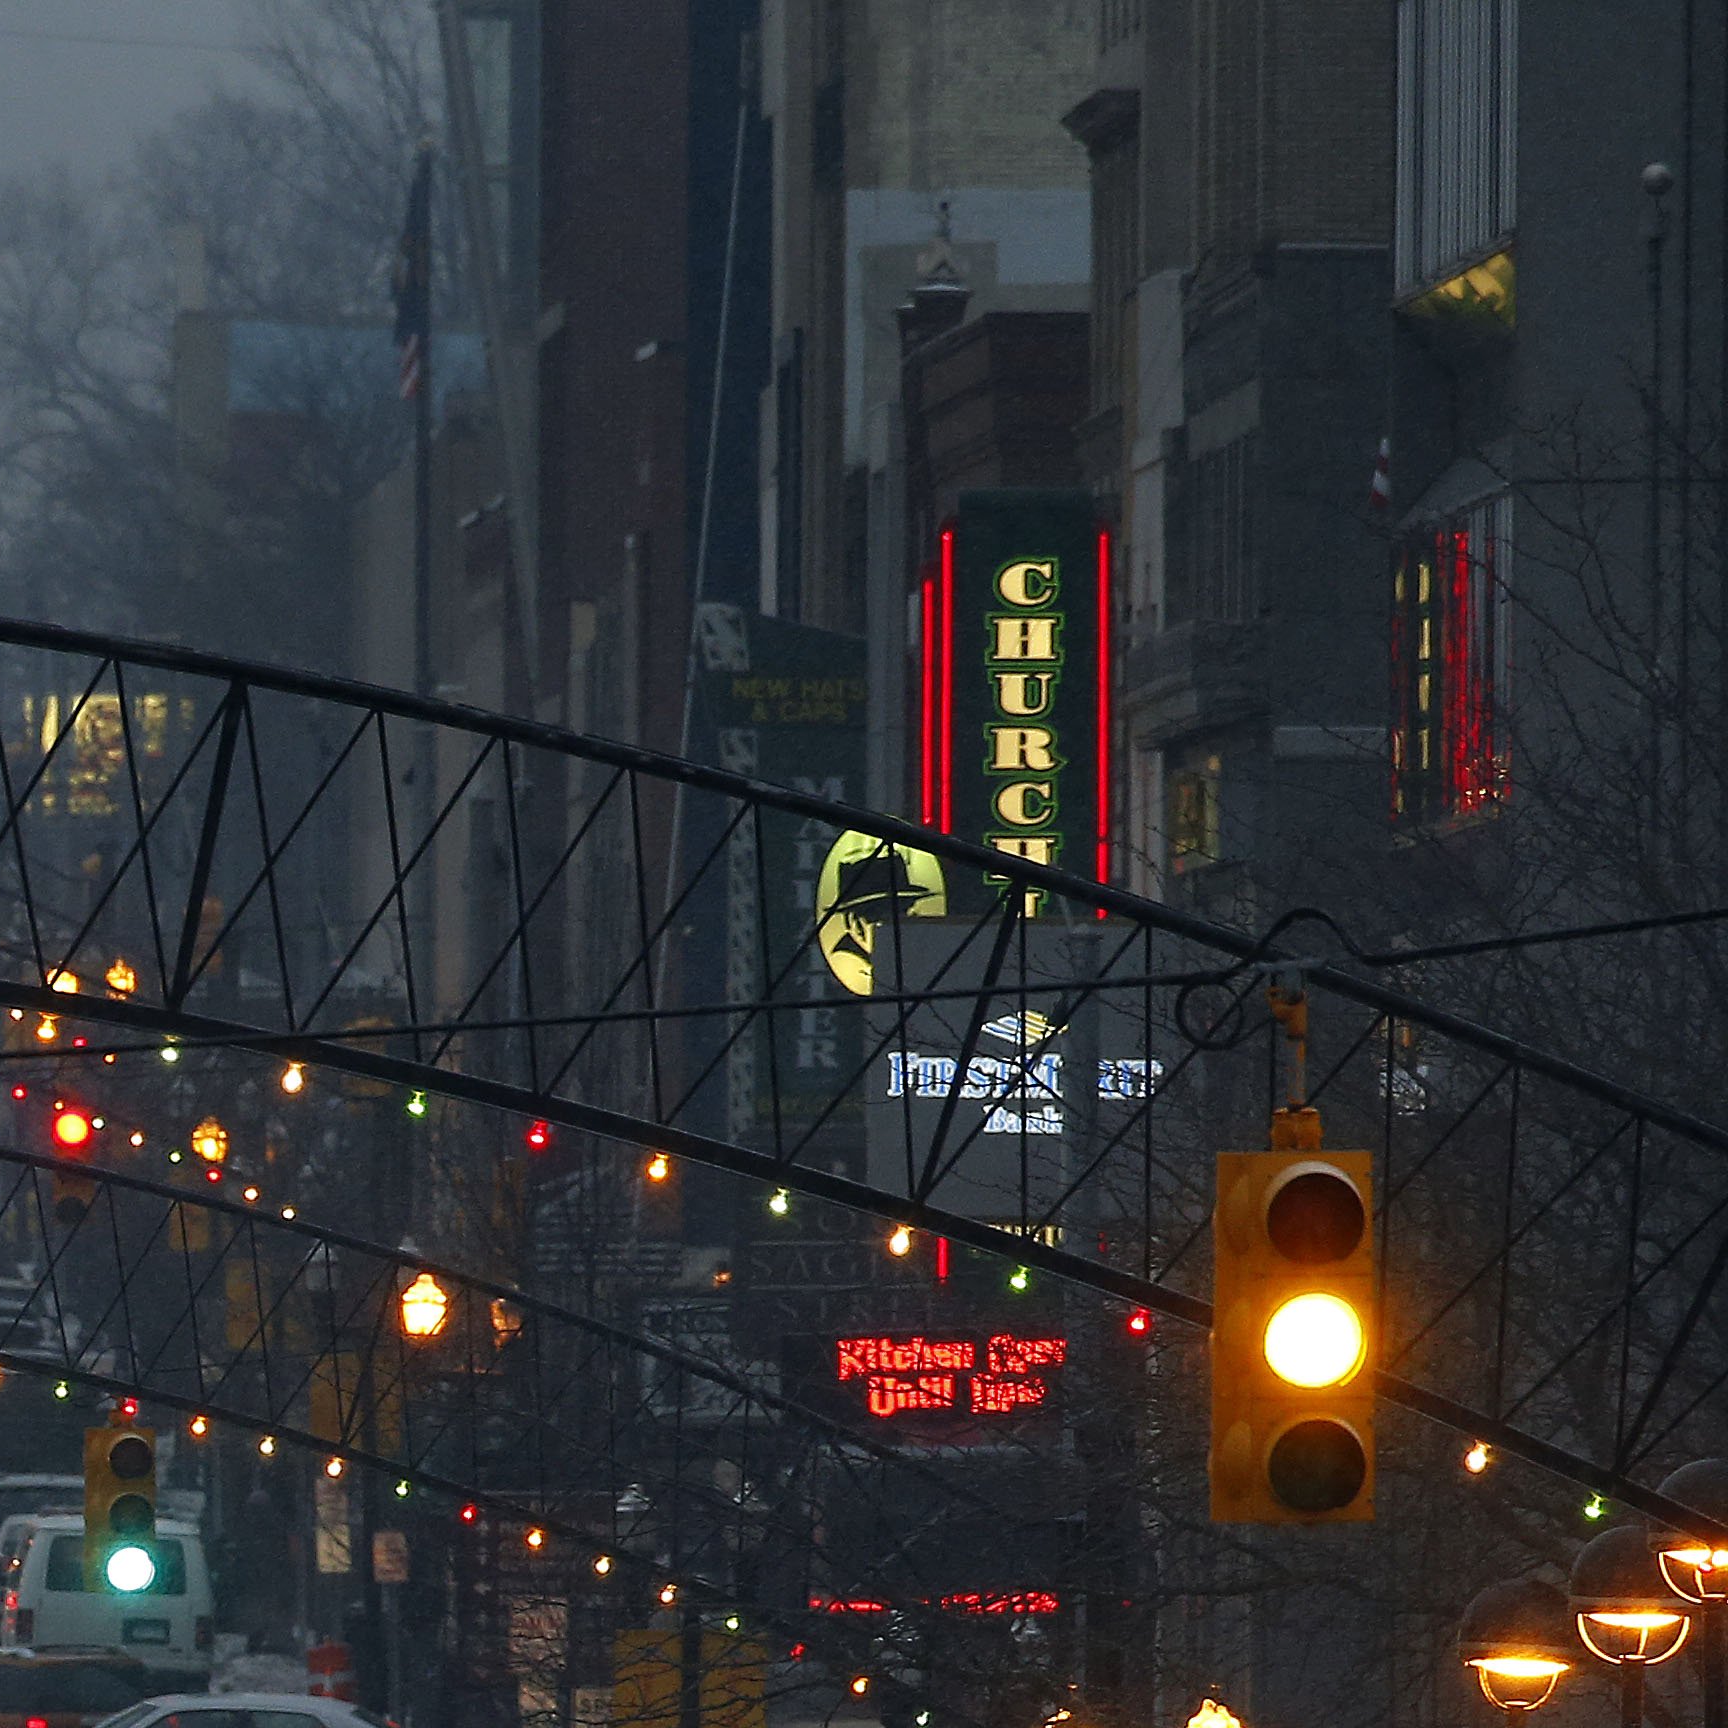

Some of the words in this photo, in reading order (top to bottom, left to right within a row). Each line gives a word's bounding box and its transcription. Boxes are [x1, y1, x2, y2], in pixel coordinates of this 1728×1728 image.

[732, 677, 790, 699] NEW
[780, 701, 847, 721] CAPS
[983, 1104, 1063, 1134] Bank
[837, 1335, 976, 1380] Kitchen
[867, 1373, 955, 1417] Until
